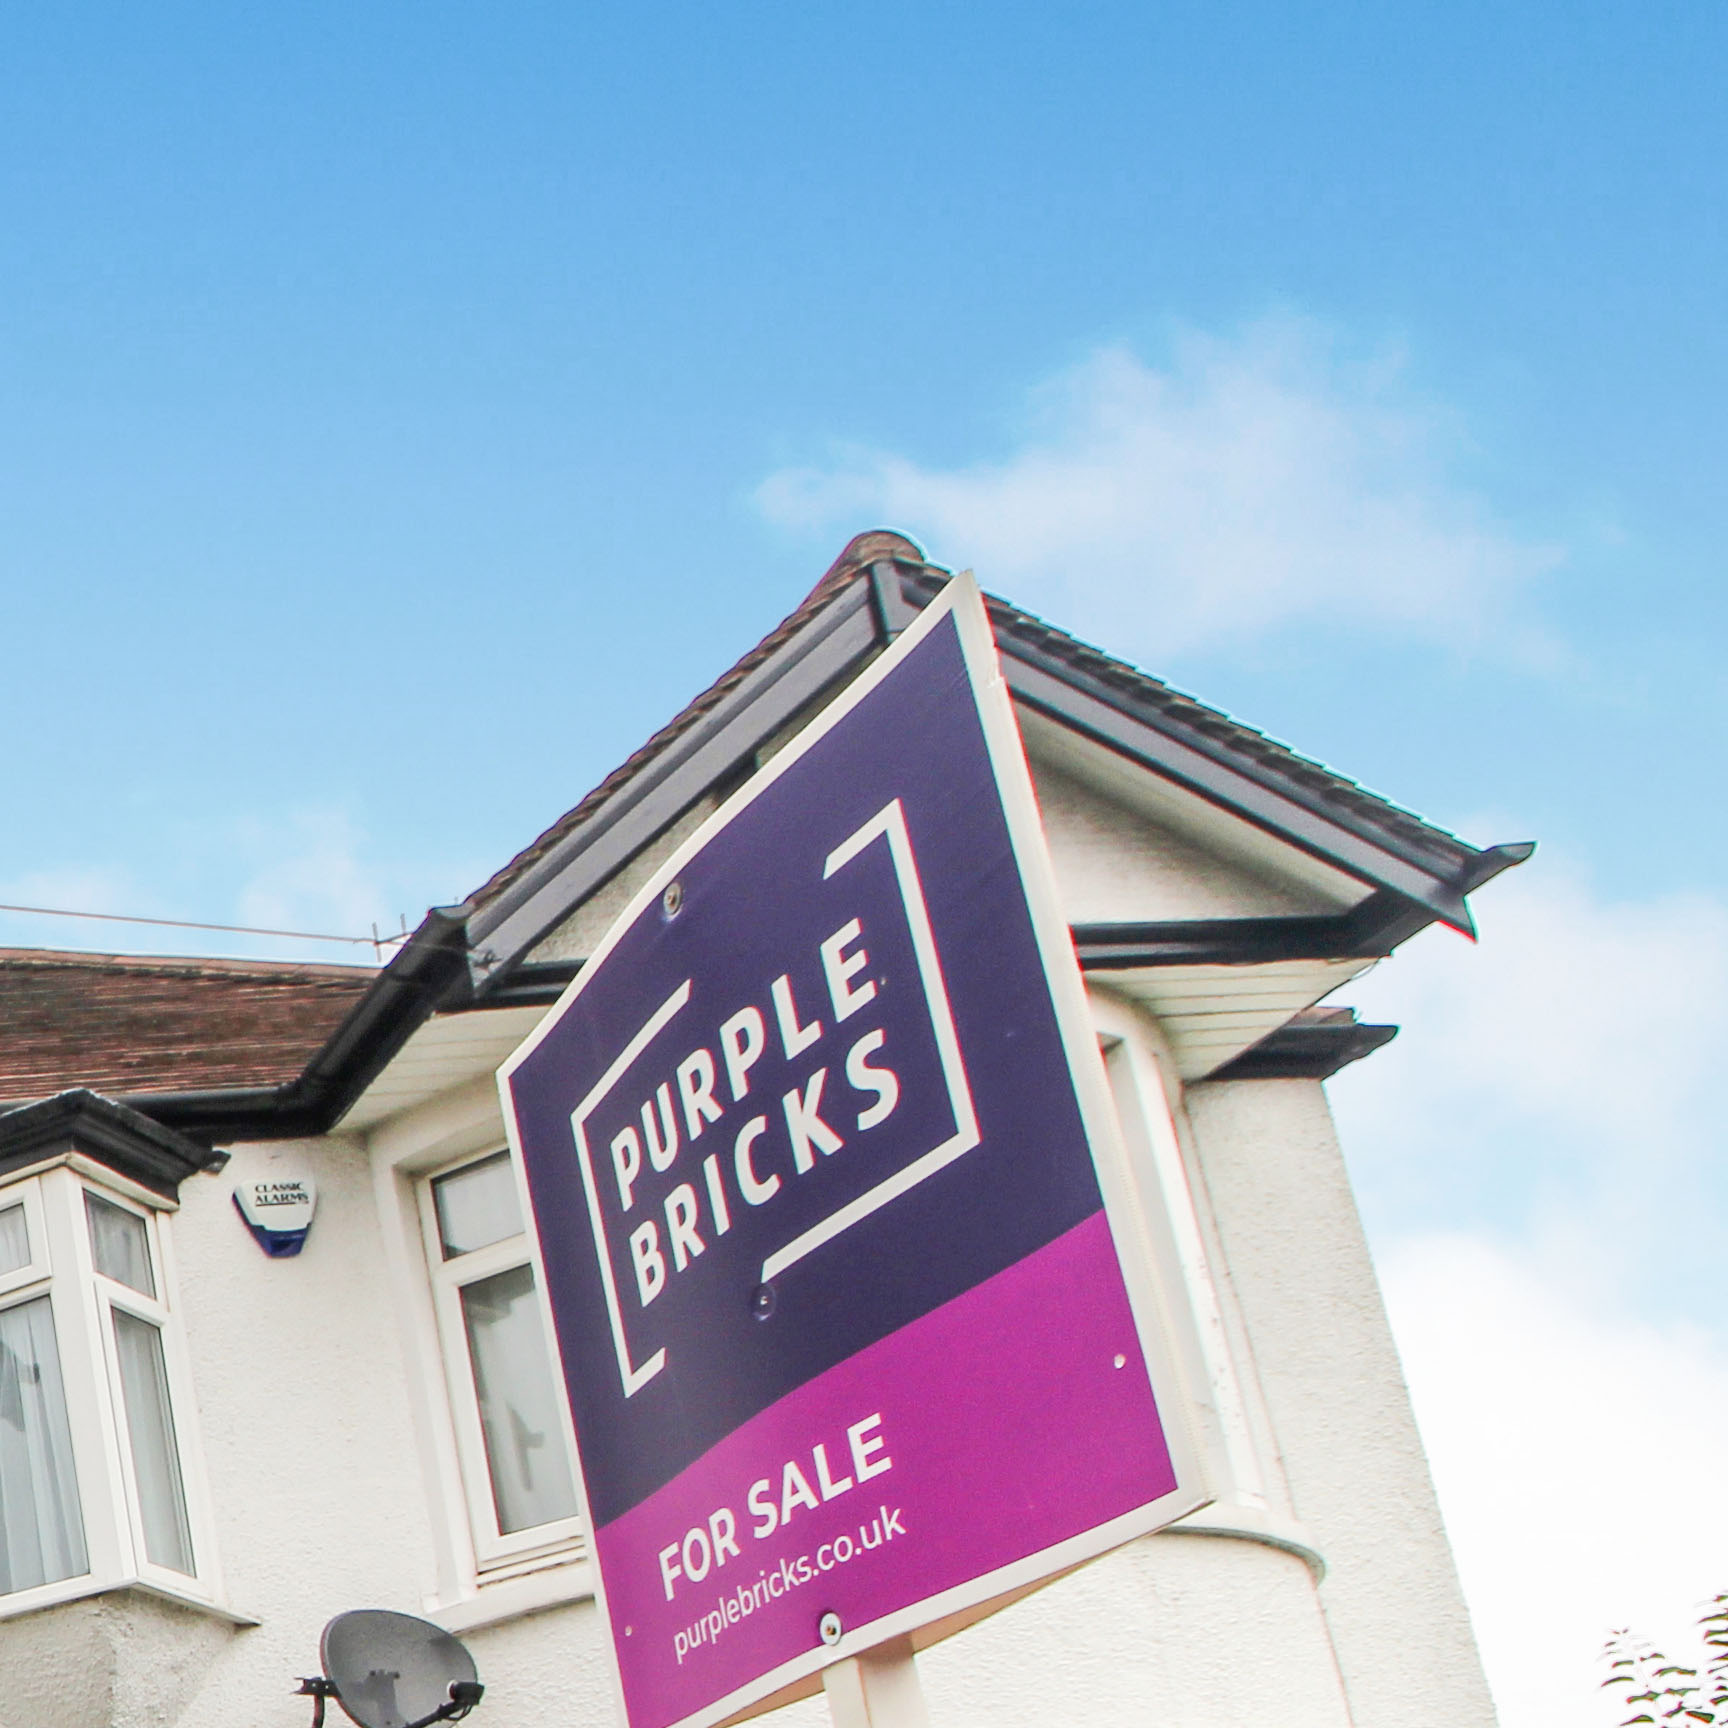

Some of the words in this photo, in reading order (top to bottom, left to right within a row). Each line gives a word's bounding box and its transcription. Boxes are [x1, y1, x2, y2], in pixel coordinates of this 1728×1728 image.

[610, 917, 877, 1212] PURPLE
[255, 1183, 304, 1193] CLASSIC
[255, 1193, 309, 1204] ALARMS
[629, 1028, 901, 1308] BRICKS
[658, 1507, 741, 1602] FOR
[747, 1412, 893, 1539] SALE
[673, 1505, 907, 1664] purplebricks.co.uk
